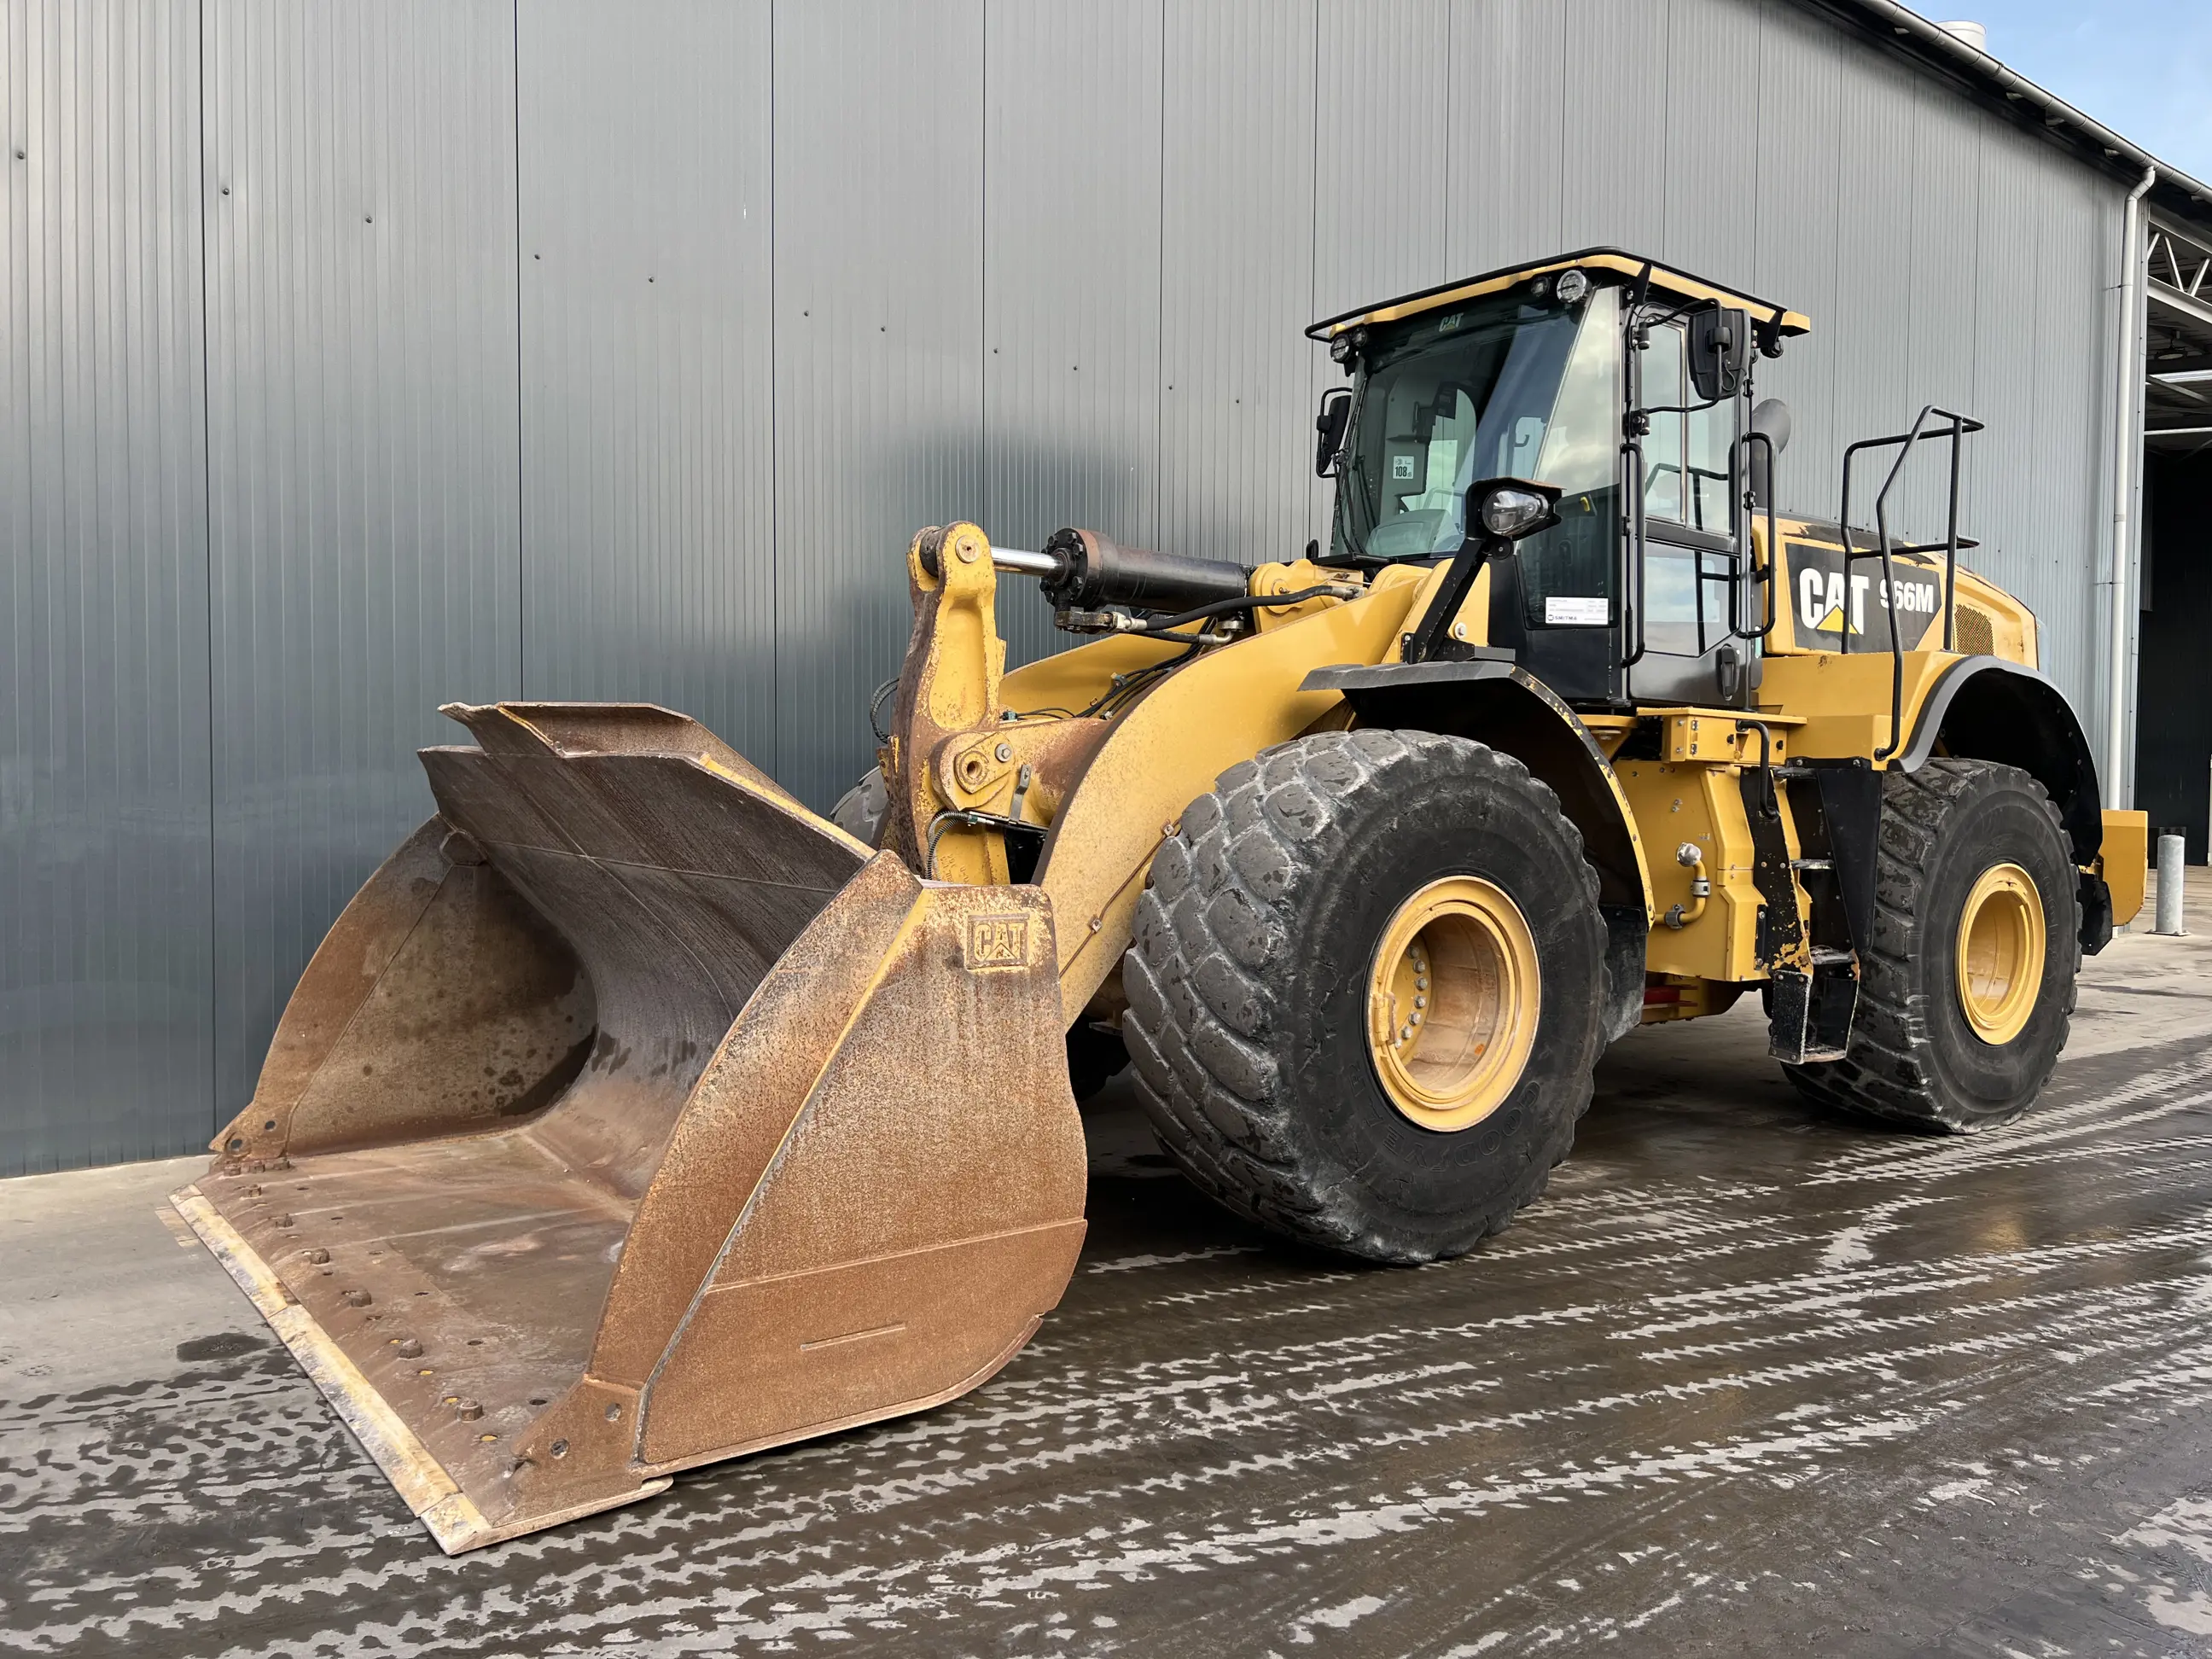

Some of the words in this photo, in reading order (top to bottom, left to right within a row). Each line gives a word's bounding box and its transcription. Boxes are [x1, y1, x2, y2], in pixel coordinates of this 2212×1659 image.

[1439, 312, 1464, 332] CAT
[1395, 466, 1407, 477] 108
[1799, 568, 1870, 635] CAT
[974, 923, 1024, 962] CAT
